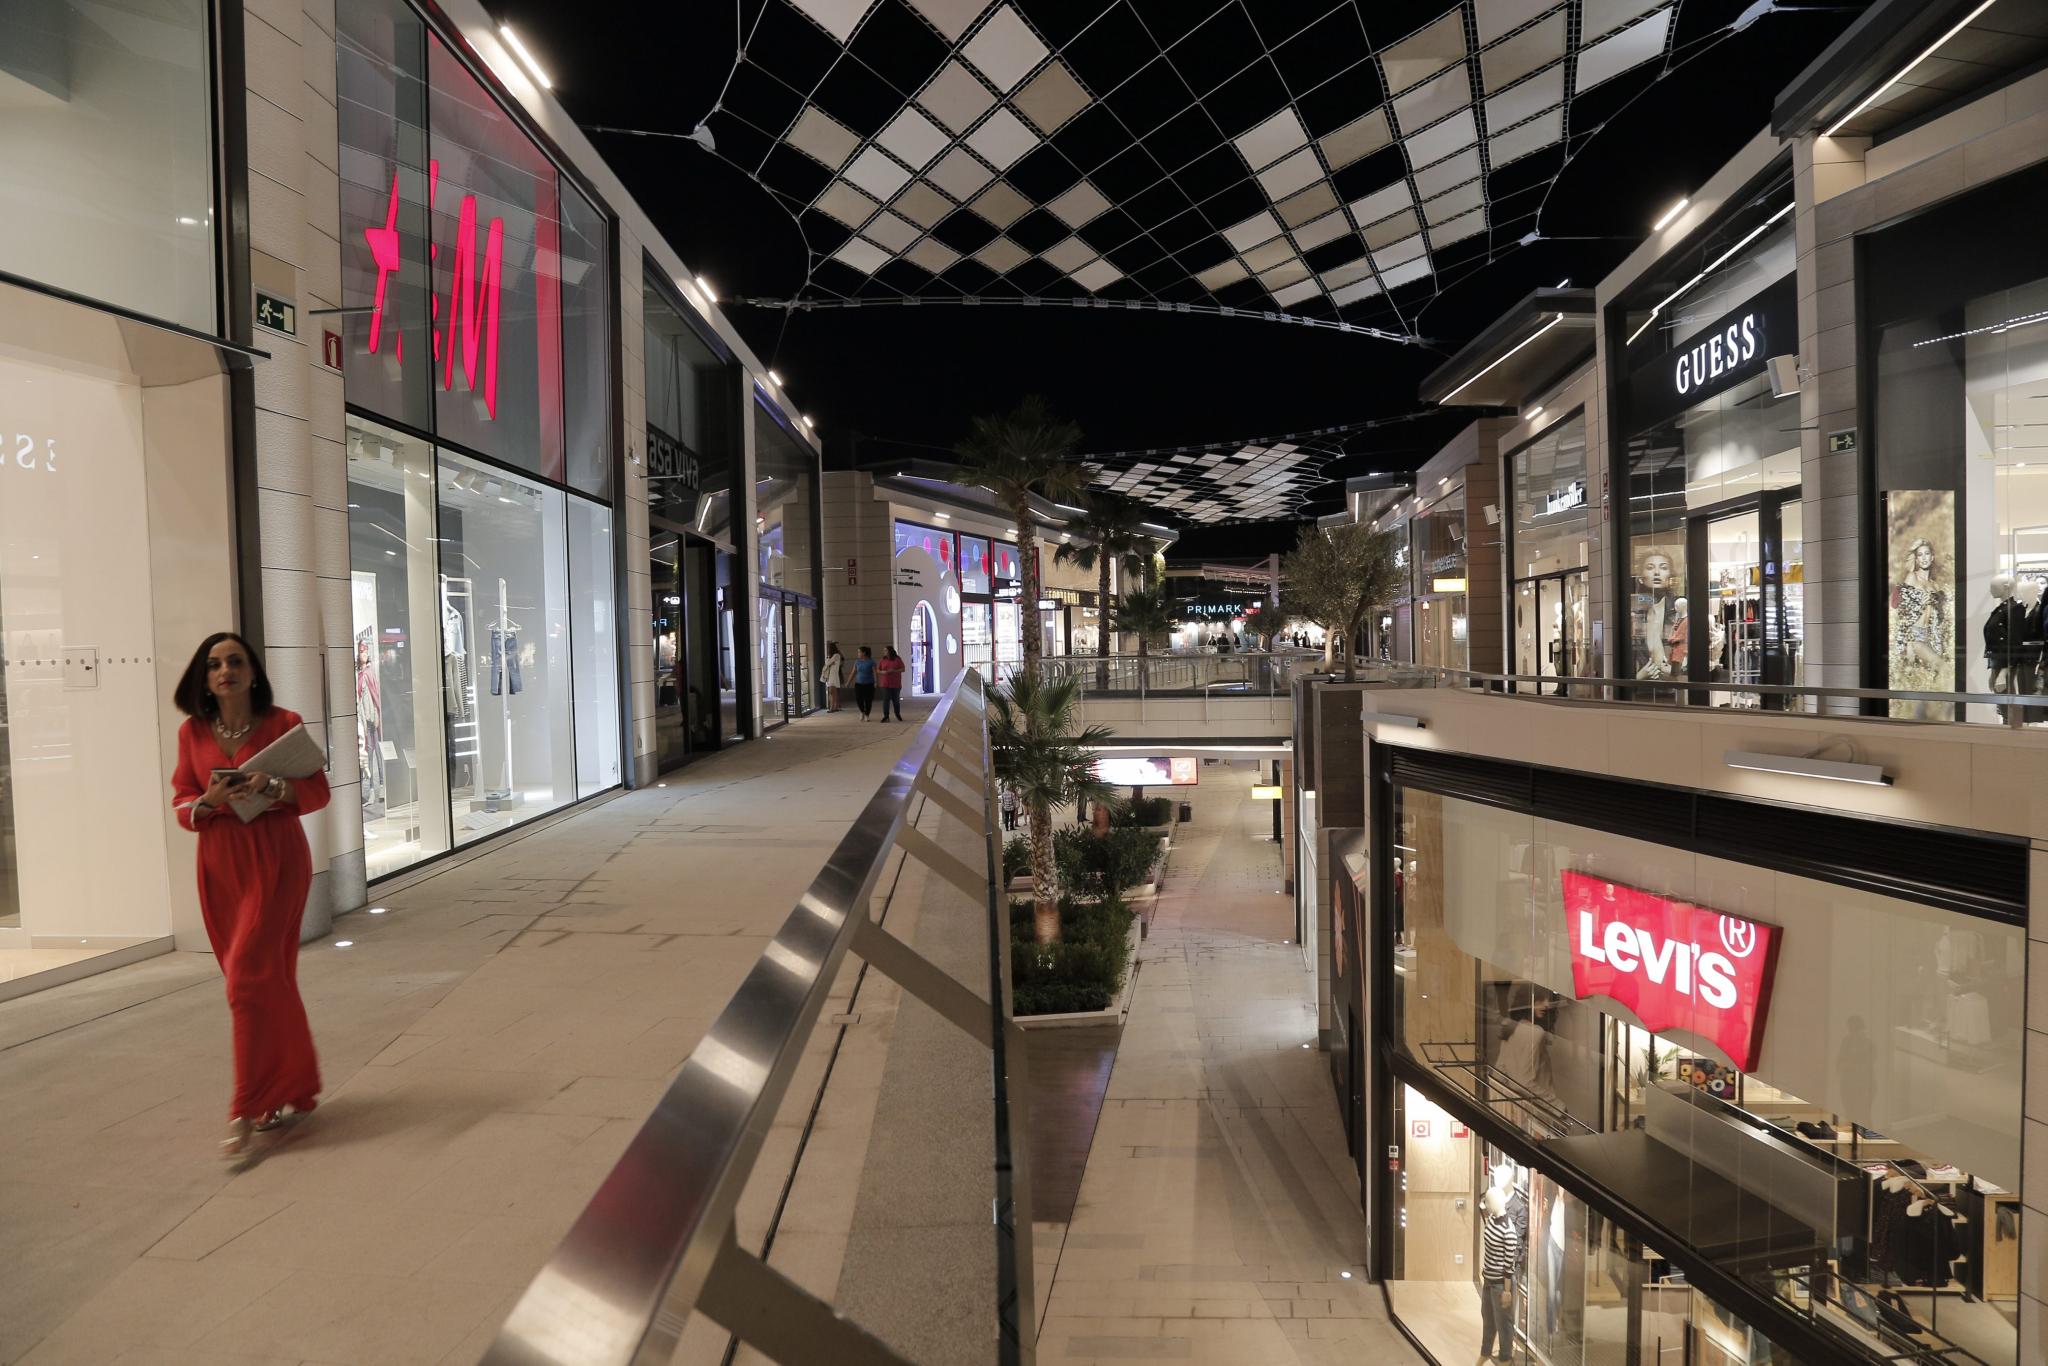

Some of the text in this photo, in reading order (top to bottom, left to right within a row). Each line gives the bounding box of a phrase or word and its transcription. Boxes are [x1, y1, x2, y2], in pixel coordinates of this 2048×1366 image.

[1676, 313, 1755, 394] GUESS
[648, 432, 672, 476] asa
[1187, 604, 1242, 614] PRIMARK
